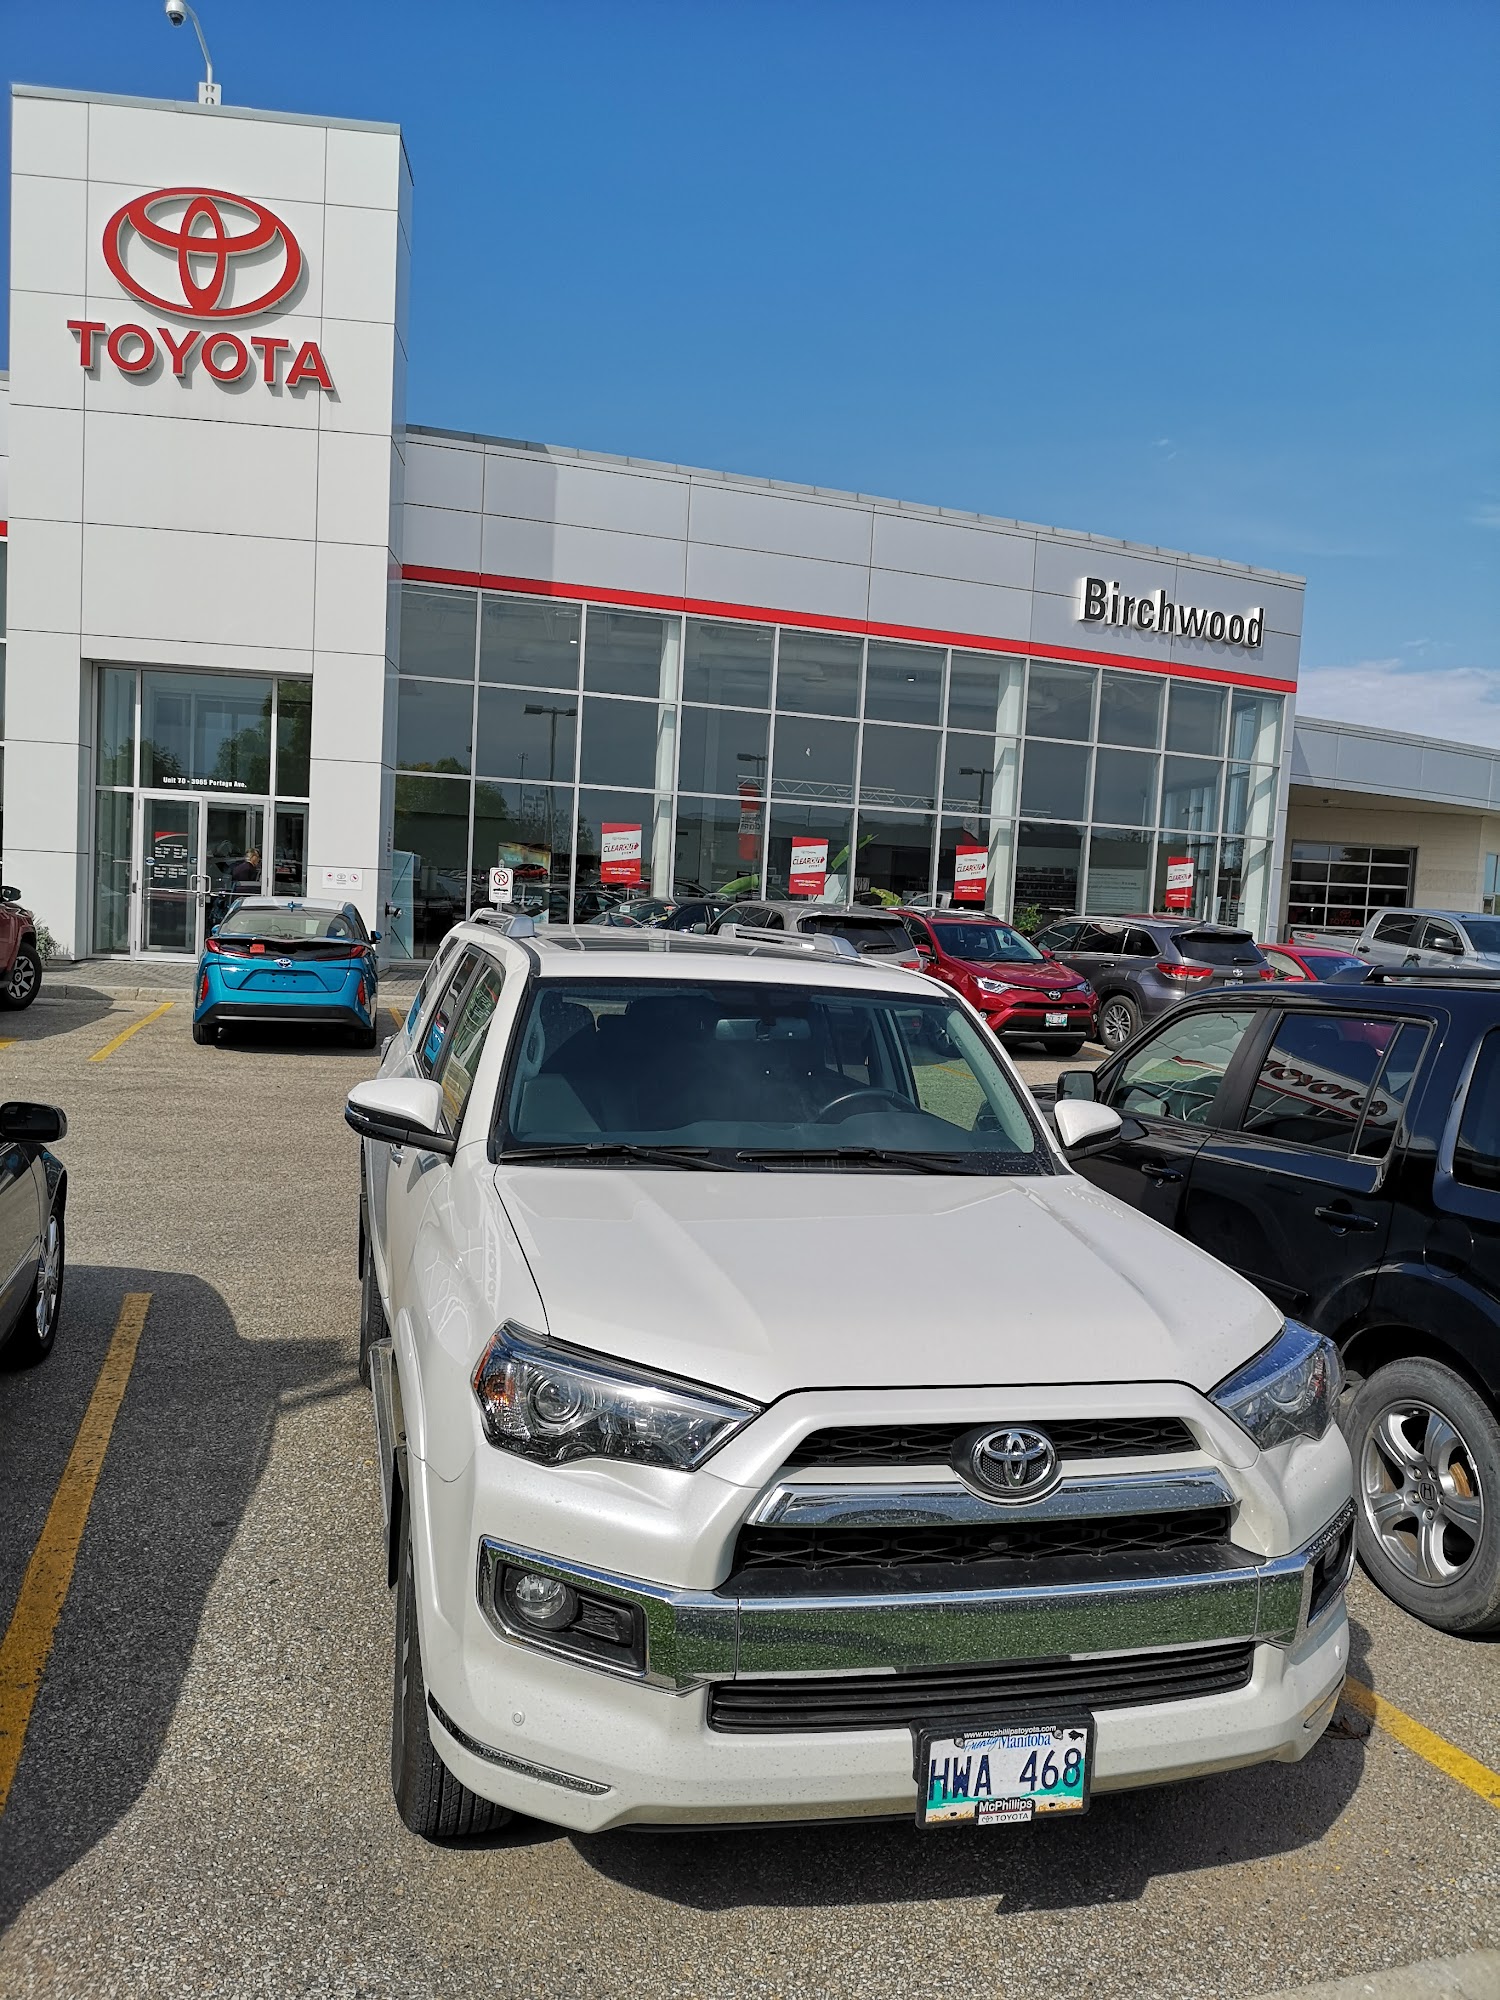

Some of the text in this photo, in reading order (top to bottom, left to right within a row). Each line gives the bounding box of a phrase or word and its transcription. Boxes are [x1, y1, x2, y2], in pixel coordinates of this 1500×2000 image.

[67, 319, 335, 392] TOYOTA
[1079, 576, 1265, 648] Birchwood
[1329, 918, 1361, 926] TOYOTA
[963, 1725, 1057, 1739] www.mcphillipstoyota.com
[999, 1733, 1052, 1750] Manitoba
[928, 1747, 1083, 1801] HWA 468
[978, 1799, 1033, 1814] McPhillips
[994, 1813, 1030, 1822] TOYOTA
